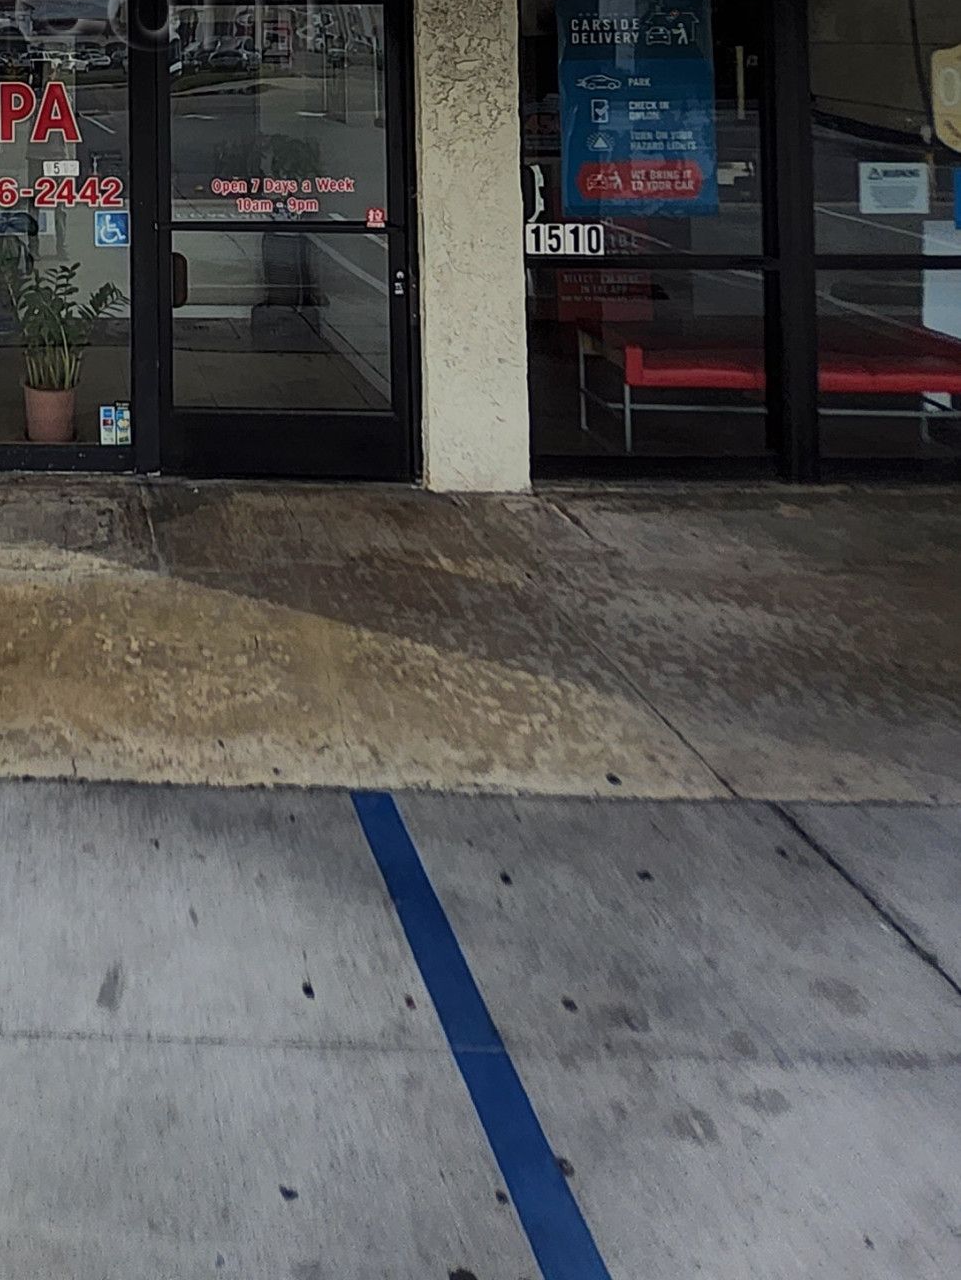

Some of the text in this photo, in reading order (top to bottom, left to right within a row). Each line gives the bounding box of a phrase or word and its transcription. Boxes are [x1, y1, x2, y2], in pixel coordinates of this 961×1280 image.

[571, 18, 639, 31] CARSIDE
[571, 32, 639, 44] DELIVERY
[649, 170, 680, 180] BRING
[211, 177, 355, 195] Open 7 Days a Week
[631, 180, 695, 191] TO YOUR CAR
[236, 198, 274, 212] 10am
[287, 197, 319, 214] 9pm
[530, 225, 602, 254] 1510
